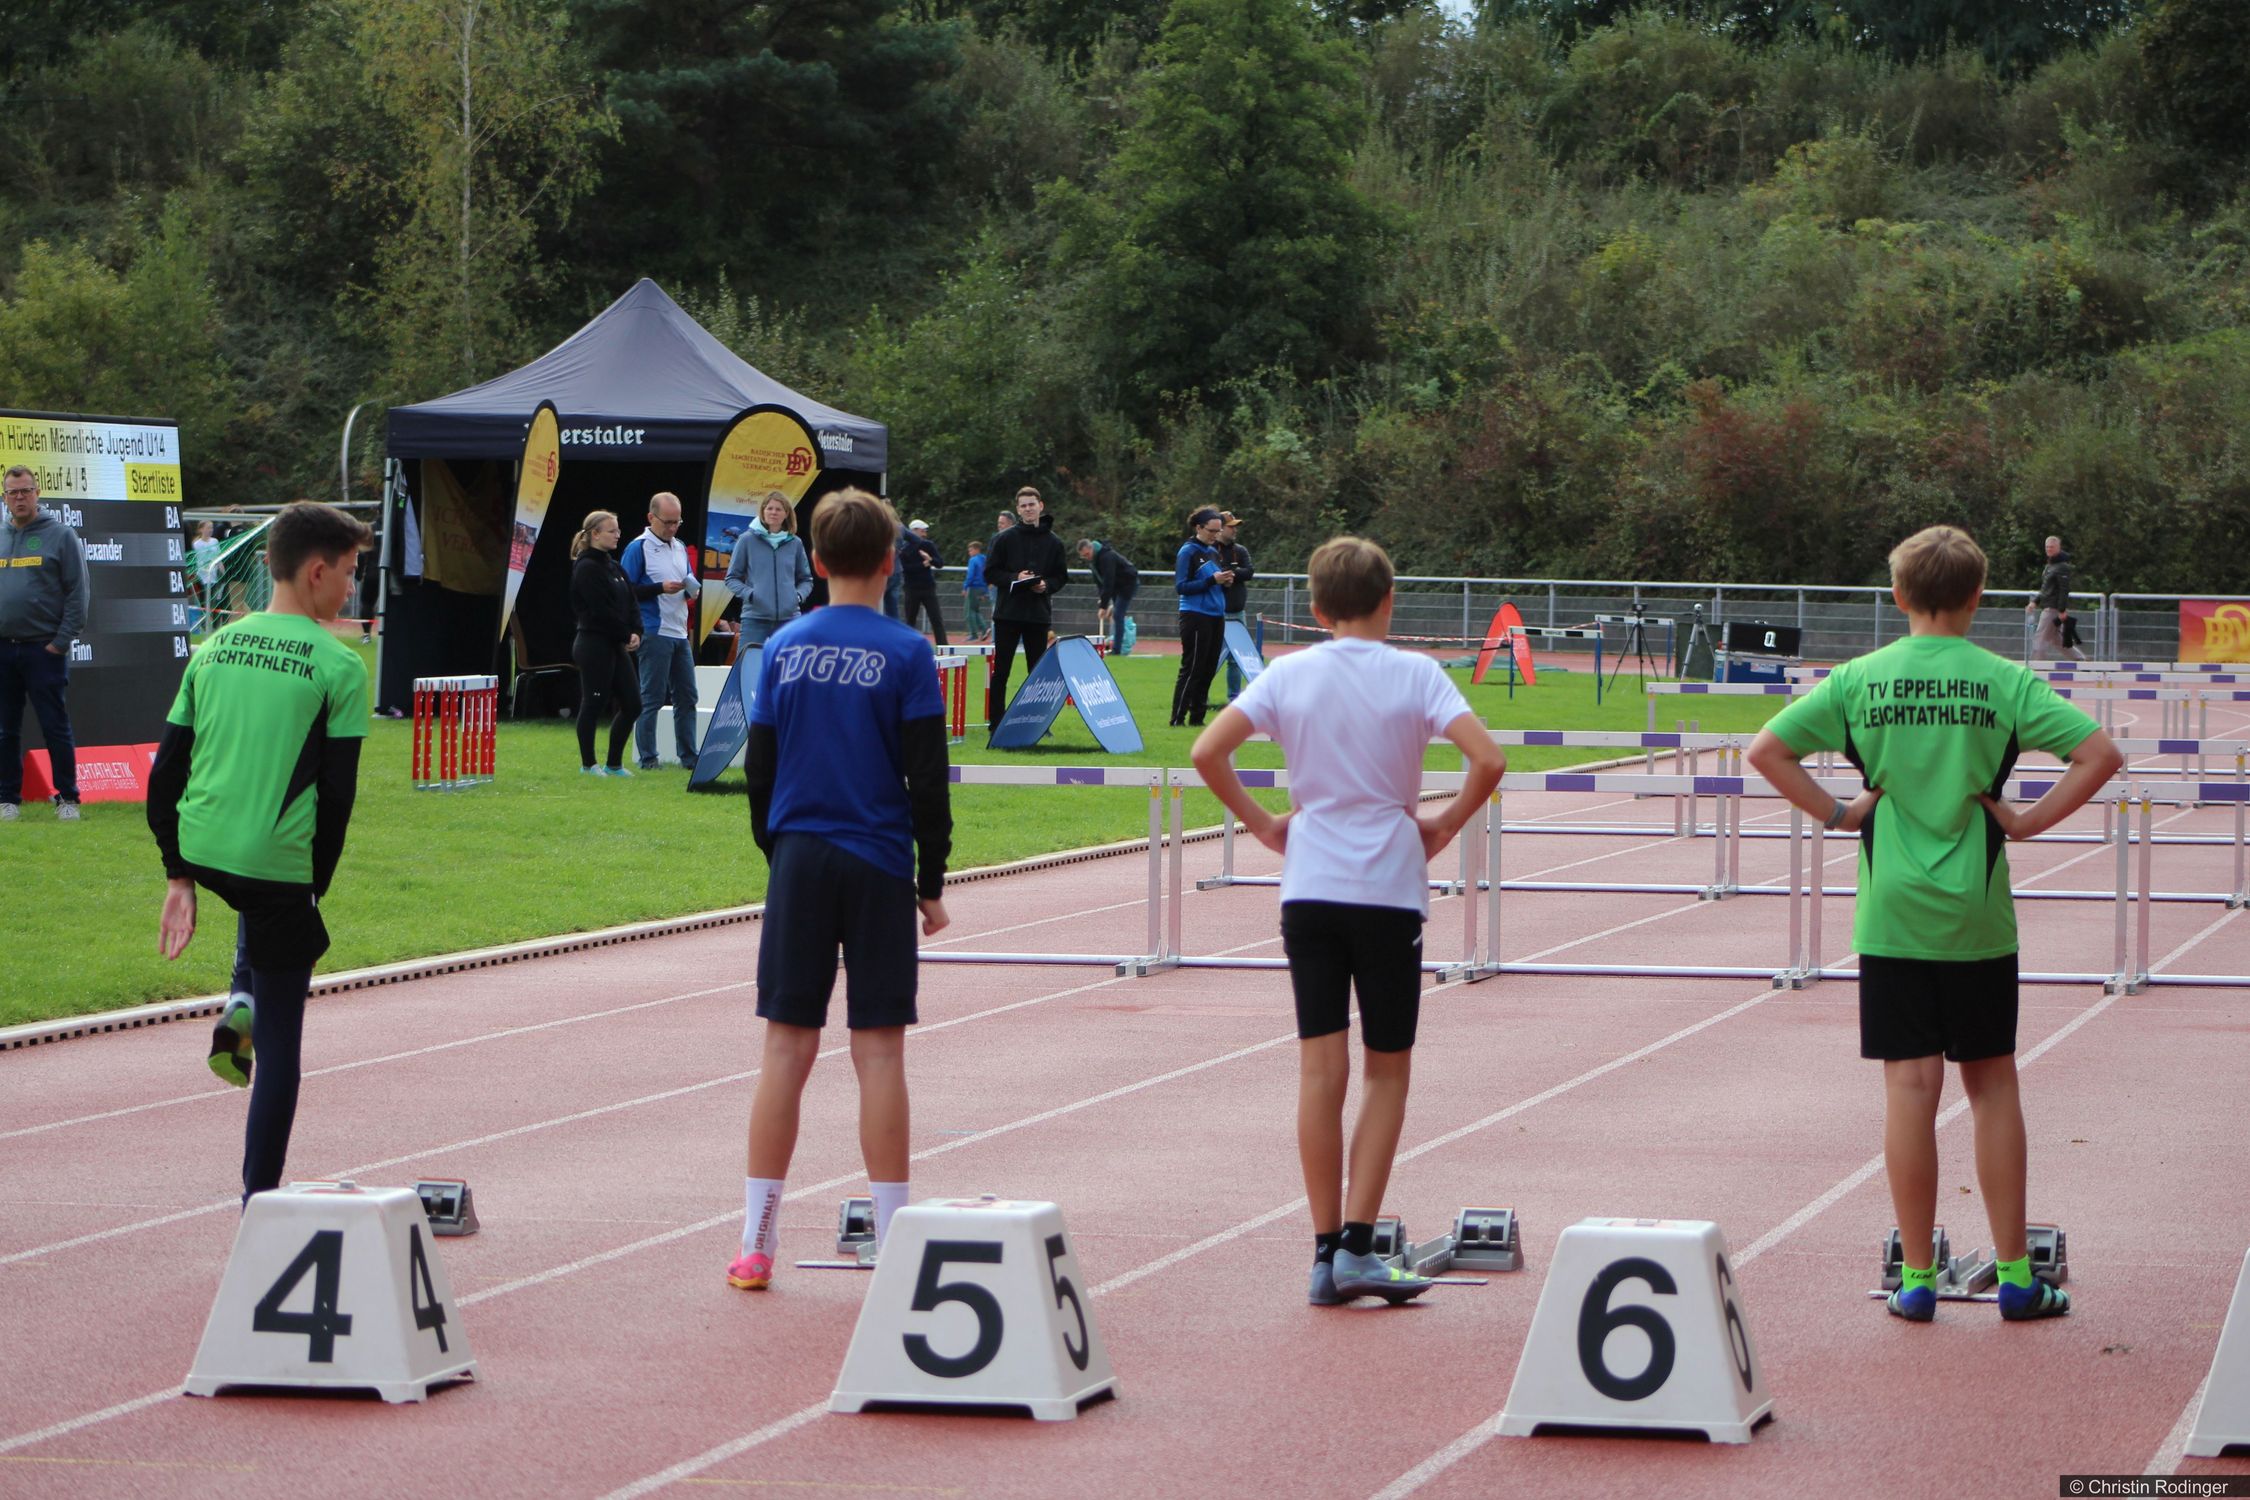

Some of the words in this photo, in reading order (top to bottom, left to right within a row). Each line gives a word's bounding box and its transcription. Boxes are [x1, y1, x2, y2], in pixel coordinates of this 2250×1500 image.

[8, 425, 48, 451] Hürden
[50, 427, 104, 454] Männliche
[107, 431, 145, 461] Jugend
[146, 433, 166, 456] U14
[560, 425, 646, 445] erstaler
[65, 466, 73, 491] 4
[81, 467, 88, 492] 5
[132, 469, 176, 494] Startliste
[63, 503, 83, 527] Ben
[165, 506, 181, 529] BA
[168, 538, 183, 561] BA
[169, 571, 185, 593] BA
[172, 603, 187, 625] BA
[70, 639, 93, 662] Finn
[174, 636, 189, 658] BA
[213, 632, 230, 649] TV
[231, 633, 315, 659] EPPELHEIM
[200, 650, 316, 681] LEICHTATHLETIK
[1867, 681, 1889, 701] TV
[1893, 678, 1989, 702] EPPELHEIM
[1863, 704, 1997, 729] LEICHTATHLETIK
[252, 1229, 353, 1363] 4
[410, 1223, 449, 1354] 4
[1044, 1232, 1090, 1371] 5
[902, 1239, 1004, 1378] 5
[1577, 1256, 1679, 1402] 6
[1716, 1251, 1752, 1394] 6
